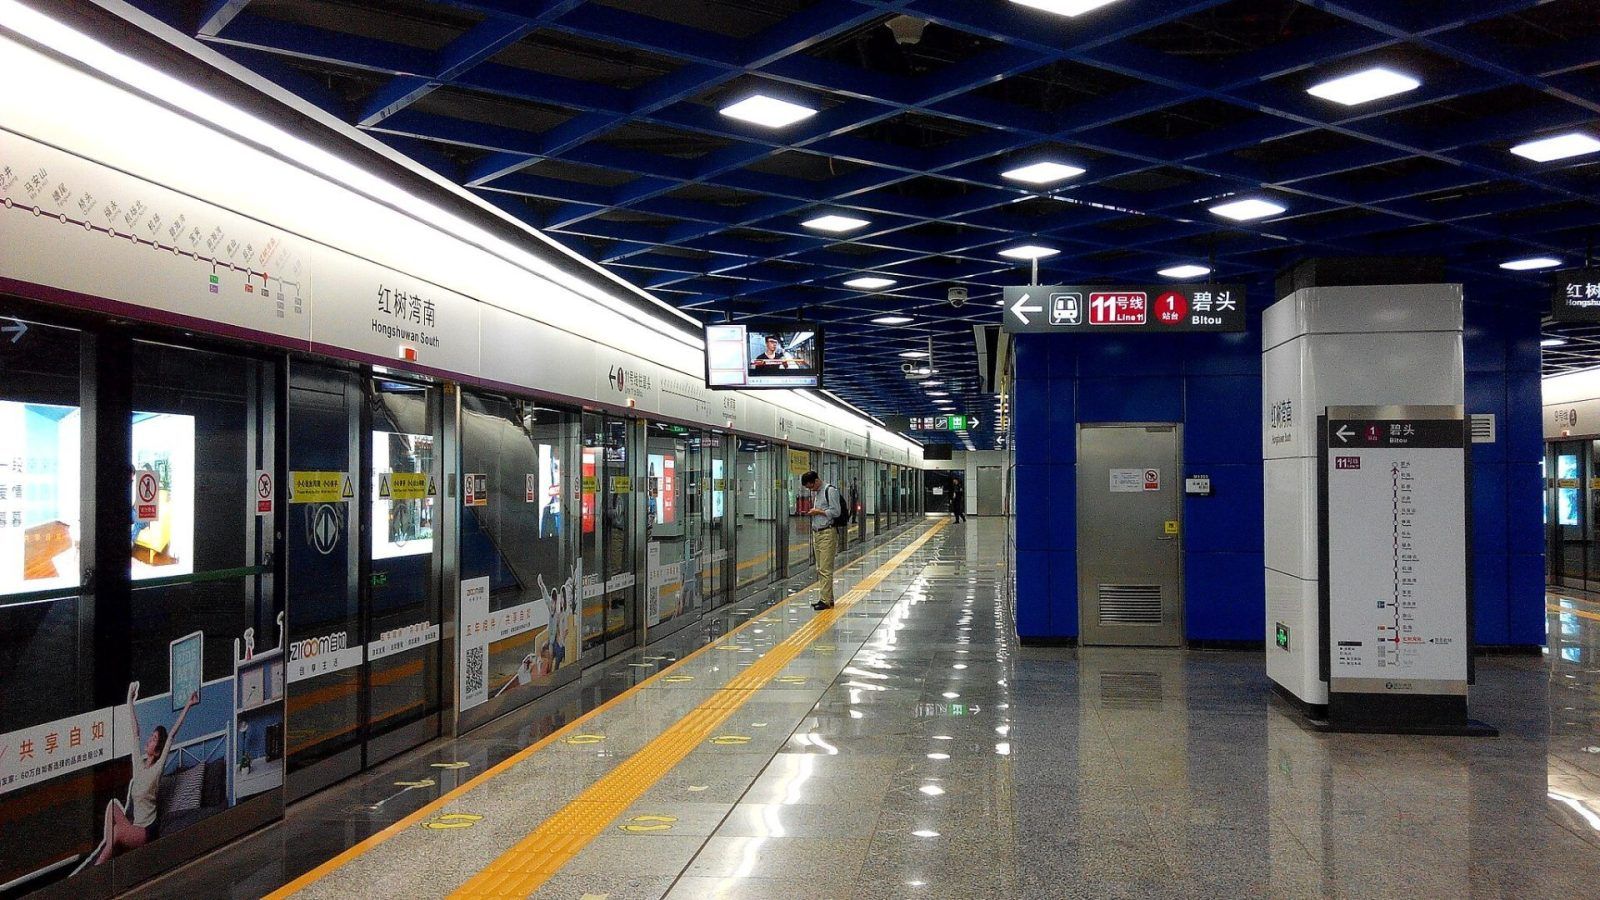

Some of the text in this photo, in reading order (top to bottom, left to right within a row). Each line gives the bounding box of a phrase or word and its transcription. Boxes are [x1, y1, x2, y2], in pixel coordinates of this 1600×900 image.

[377, 284, 435, 328] 红树湾南
[1166, 295, 1174, 310] 1
[1192, 291, 1236, 312] 碧头
[1116, 312, 1136, 321] Line
[1162, 312, 1178, 321] 站台
[1192, 315, 1222, 325] Bitou
[371, 319, 440, 348] Hongshuwan South
[1389, 423, 1415, 436] 碧头
[290, 635, 330, 661] ziroom
[330, 631, 347, 651] 自如
[20, 720, 104, 761] 共享自如
